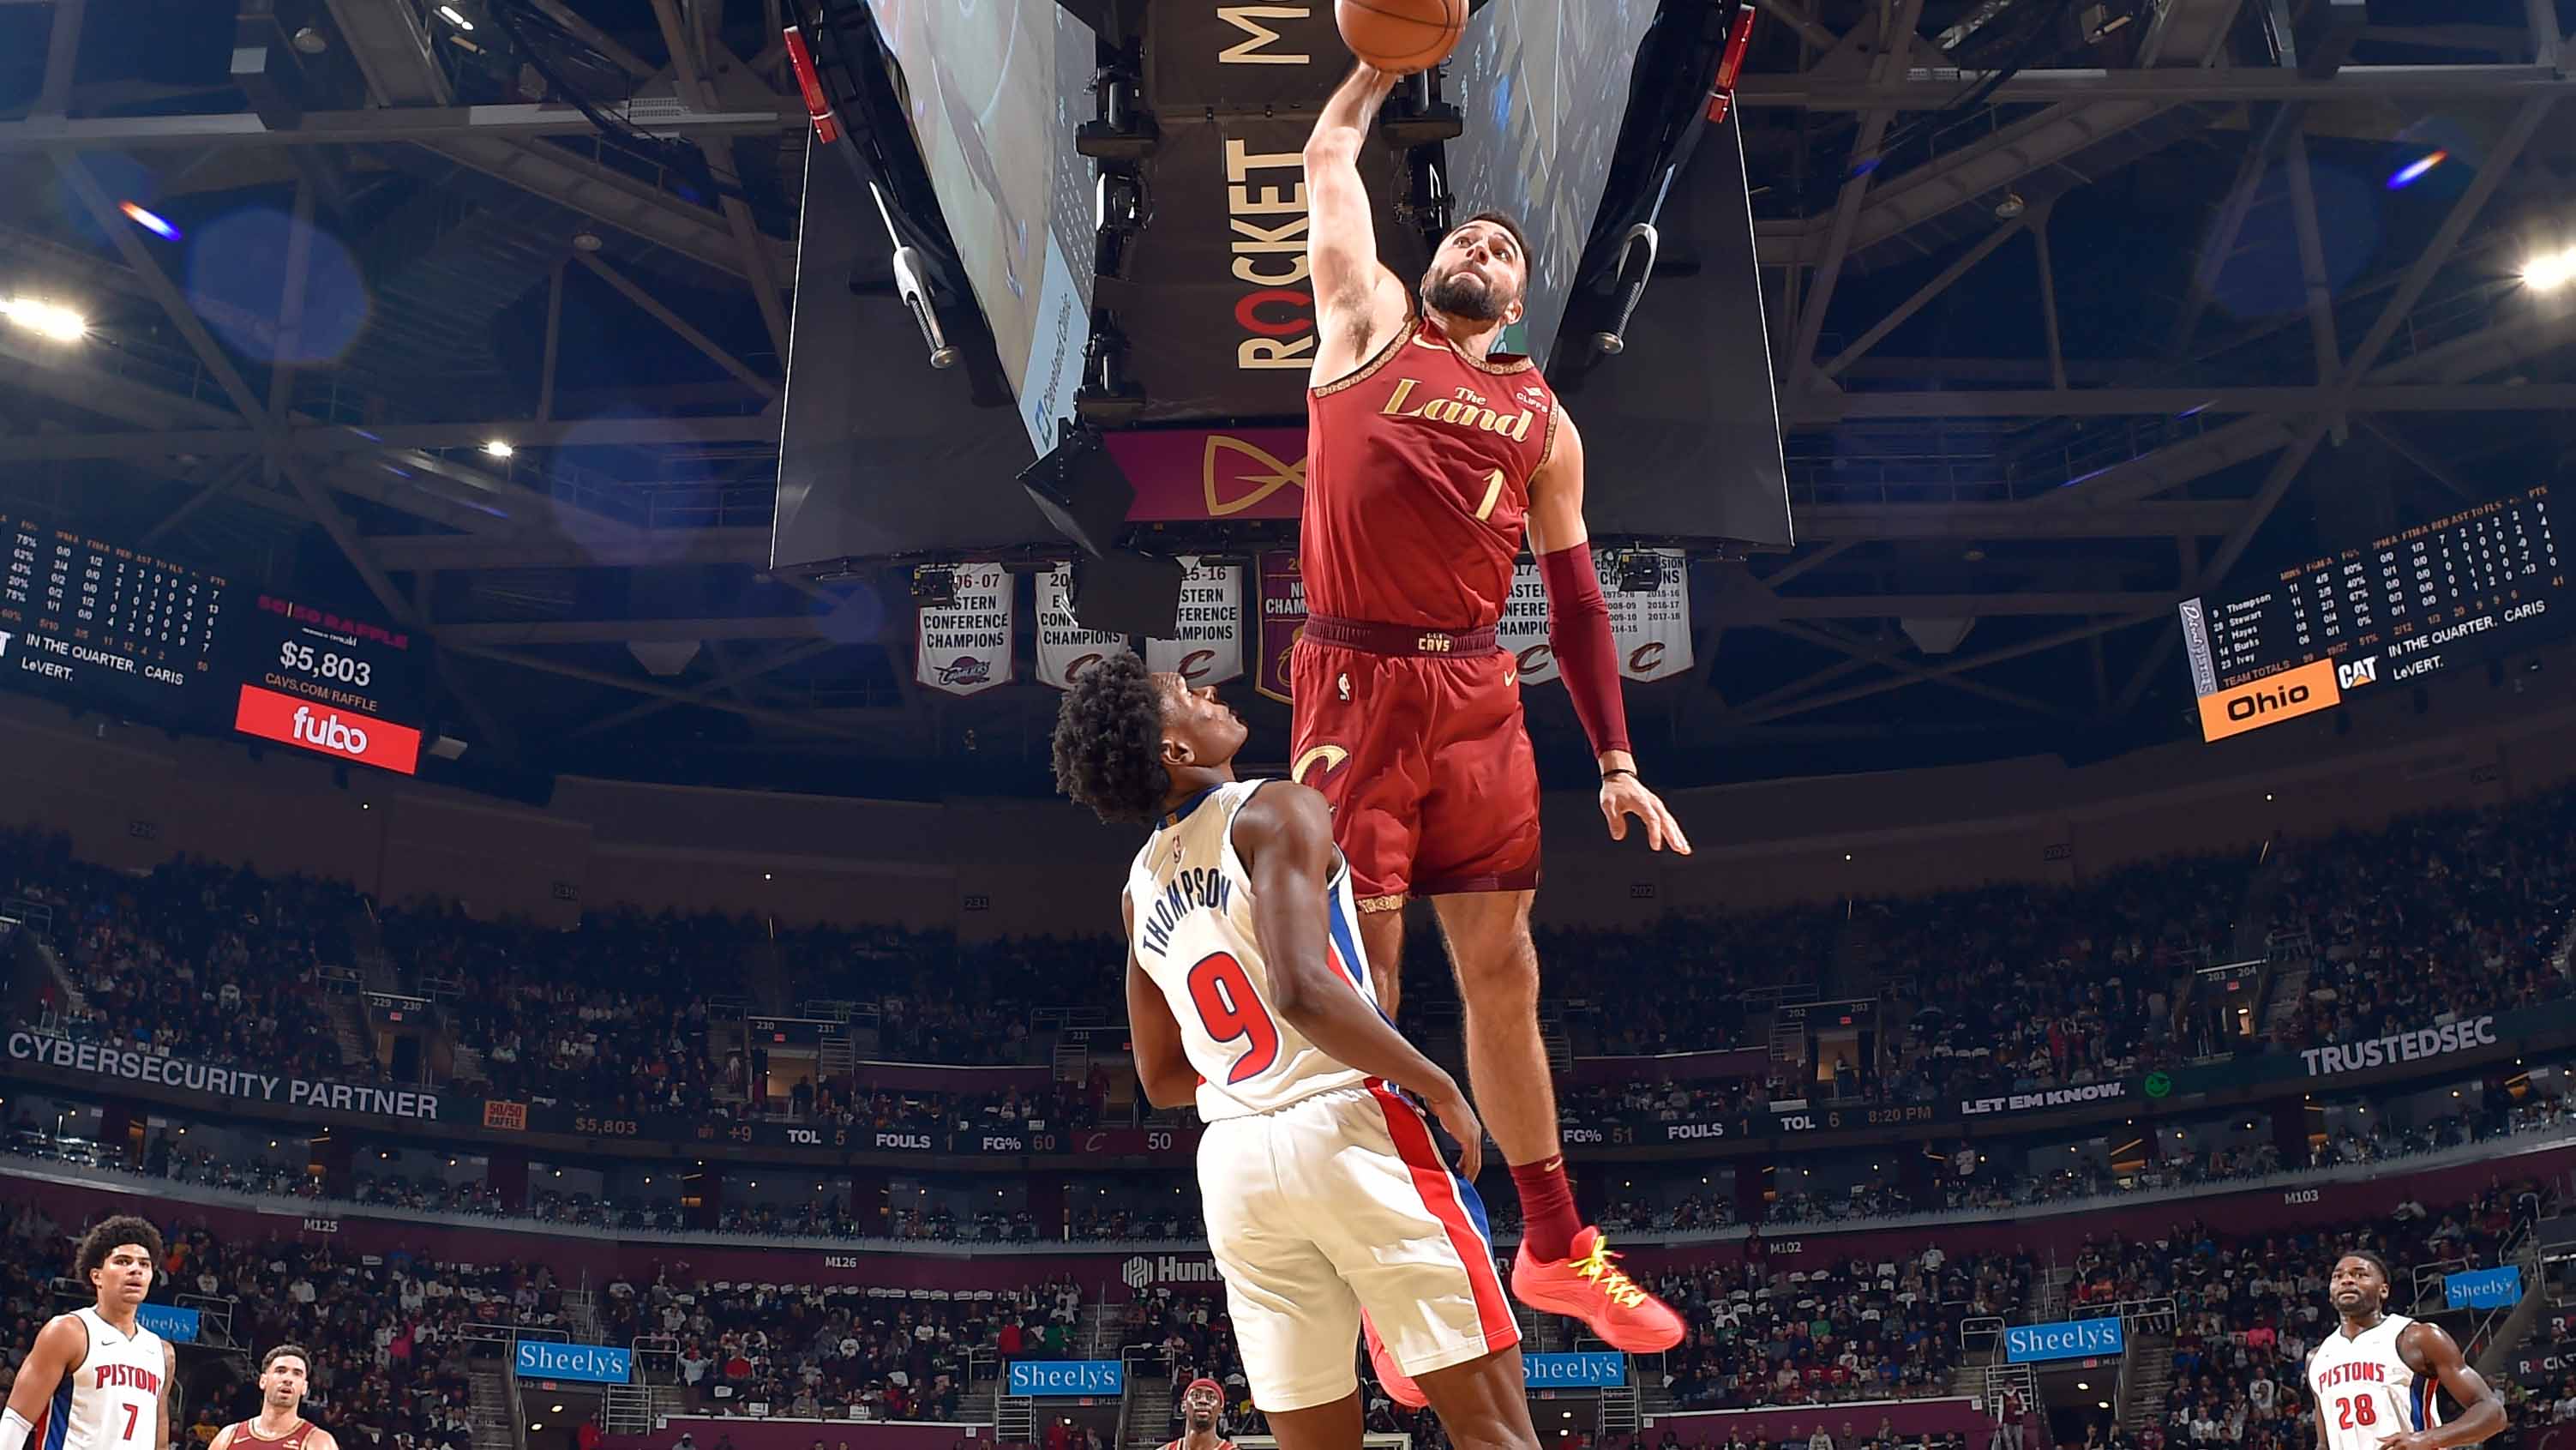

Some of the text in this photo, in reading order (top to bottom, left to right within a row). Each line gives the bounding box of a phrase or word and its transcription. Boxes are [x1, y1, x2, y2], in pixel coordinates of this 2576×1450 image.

[1216, 0, 1311, 63] M
[1226, 139, 1314, 370] ROCKET
[1455, 387, 1486, 406] The
[1516, 392, 1548, 413] CLIFFS
[1378, 377, 1534, 442] Land
[1475, 468, 1504, 523] 1
[954, 574, 1000, 589] 06-07
[1181, 588, 1224, 603] STERN
[2226, 593, 2271, 614] Thompson
[924, 613, 1008, 629] CONFERENCE
[1178, 606, 1237, 622] FERENCE
[1608, 613, 1637, 622] 009-10
[2229, 611, 2262, 627] Stewart
[1043, 631, 1121, 645] CHAMPIONS
[1174, 625, 1233, 641] AMPIONS
[2231, 626, 2258, 641] Hayes
[2388, 599, 2546, 658] IN THE QUARTER. CARIS
[927, 632, 1004, 648] CHAMPIONS
[1418, 637, 1450, 652] CAVS
[2234, 638, 2260, 653] Burks
[21, 656, 74, 682] LeVERT.
[26, 633, 40, 647] IN
[43, 637, 69, 655] THE
[72, 646, 137, 674] QUARTER.
[144, 665, 184, 686] CARIS
[279, 640, 371, 687] $5,803
[2237, 653, 2255, 666] Ivey
[2393, 655, 2445, 681] LeVERT.
[2223, 672, 2250, 688] TEAM
[2253, 660, 2291, 678] TOTALS
[2338, 655, 2378, 690] CAT
[265, 672, 378, 713] CAVS.COM/RAFFLE
[2227, 685, 2309, 721] Ohio
[292, 706, 368, 754] fubo
[1143, 867, 1232, 958] THOMPSON
[1187, 950, 1279, 1085] 9
[2301, 1014, 2497, 1077] TRUSTEDSEC
[8, 1032, 439, 1120] CYBERSECURITY PARTNER
[1961, 1081, 2126, 1114] LET EM KNOW.
[489, 1103, 522, 1117] 50/50
[1868, 1105, 1932, 1125] 8:20 PM
[488, 1116, 522, 1128] RAFFLE
[575, 1117, 638, 1134] $5,803
[1667, 1122, 1724, 1140] FOULS
[1780, 1111, 1840, 1133] TOL 6
[787, 1128, 845, 1146] TOL 5
[876, 1133, 931, 1150] FOULS
[982, 1134, 1056, 1152] FG% 60
[1147, 1132, 1172, 1151] 50
[1563, 1128, 1603, 1144] FG%
[2285, 1190, 2319, 1206] M103
[303, 1218, 338, 1233] M125
[1770, 1241, 1802, 1255] M102
[826, 1255, 857, 1269] M126
[1158, 1256, 1223, 1282] Hunt
[2452, 1278, 2513, 1298] Sheely's
[136, 1313, 190, 1333] heely's
[2010, 1323, 2117, 1354] Sheely's
[519, 1344, 624, 1375] Sheely's
[1013, 1364, 1115, 1390] Sheely's
[2319, 1362, 2386, 1394] PISTONS
[123, 1402, 139, 1441] 7
[2336, 1393, 2376, 1430] 28
